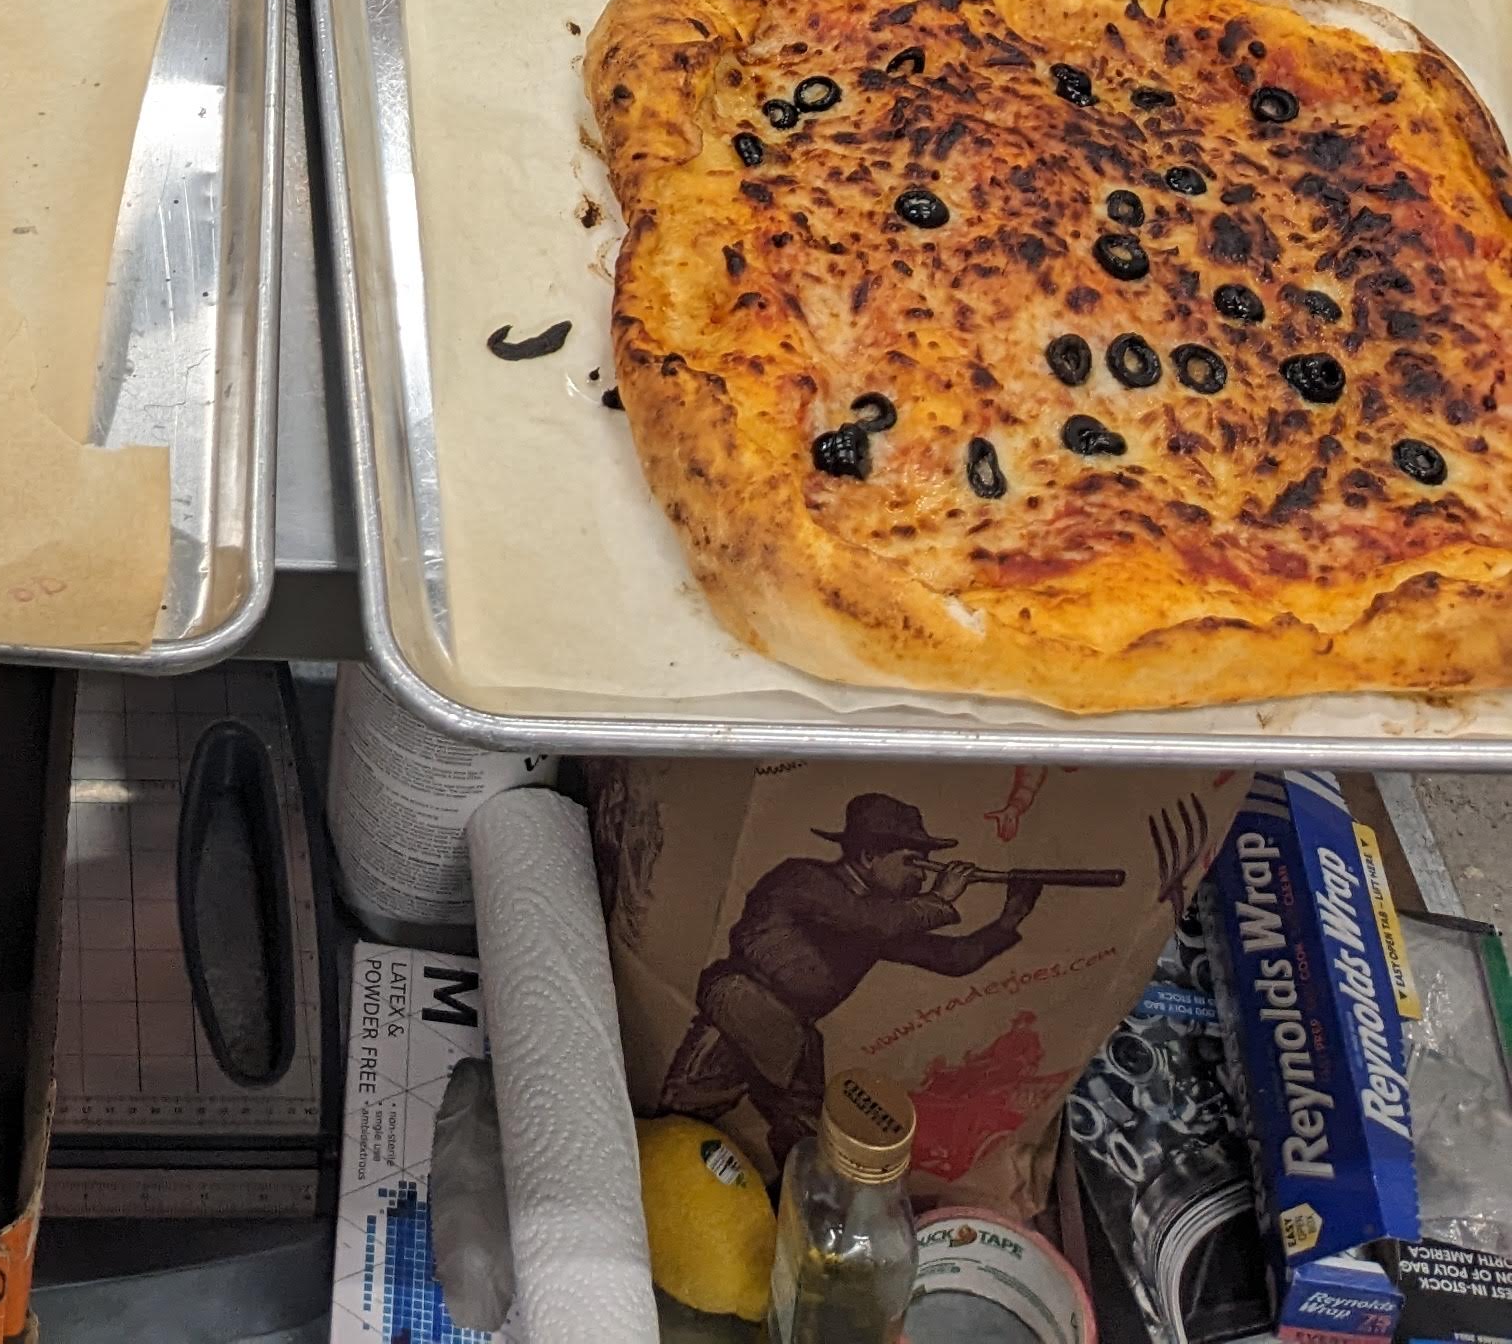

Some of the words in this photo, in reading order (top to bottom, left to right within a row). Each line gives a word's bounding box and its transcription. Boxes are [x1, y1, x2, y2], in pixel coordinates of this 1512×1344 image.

[1363, 852, 1377, 878] HERE
[1235, 832, 1287, 954] Wrap
[1316, 847, 1365, 954] Wrap
[1370, 881, 1383, 900] LIFT
[1378, 910, 1390, 929] TAB
[1384, 932, 1398, 960] OPEN
[1391, 962, 1405, 987] EASY
[362, 959, 382, 1040] POWDER
[389, 962, 407, 1020] LATEX
[421, 965, 480, 1028] M
[860, 946, 1118, 1056] www.traderjoes.com
[387, 1023, 405, 1038] &
[1334, 954, 1414, 1140] Reynolds
[359, 1046, 378, 1094] FREE
[1254, 958, 1336, 1179] Reynolds
[917, 1229, 955, 1247] UCK
[978, 1230, 1025, 1260] TAPE
[1284, 1218, 1296, 1248] EASY
[1399, 1260, 1429, 1275] BAG
[1407, 1246, 1475, 1264] AMERICA
[1433, 1265, 1469, 1281] POLY
[1472, 1269, 1492, 1283] OF
[1418, 1278, 1488, 1297] IN-STOCK
[1299, 1302, 1352, 1320] Wrap
[1308, 1291, 1397, 1312] Reynolds
